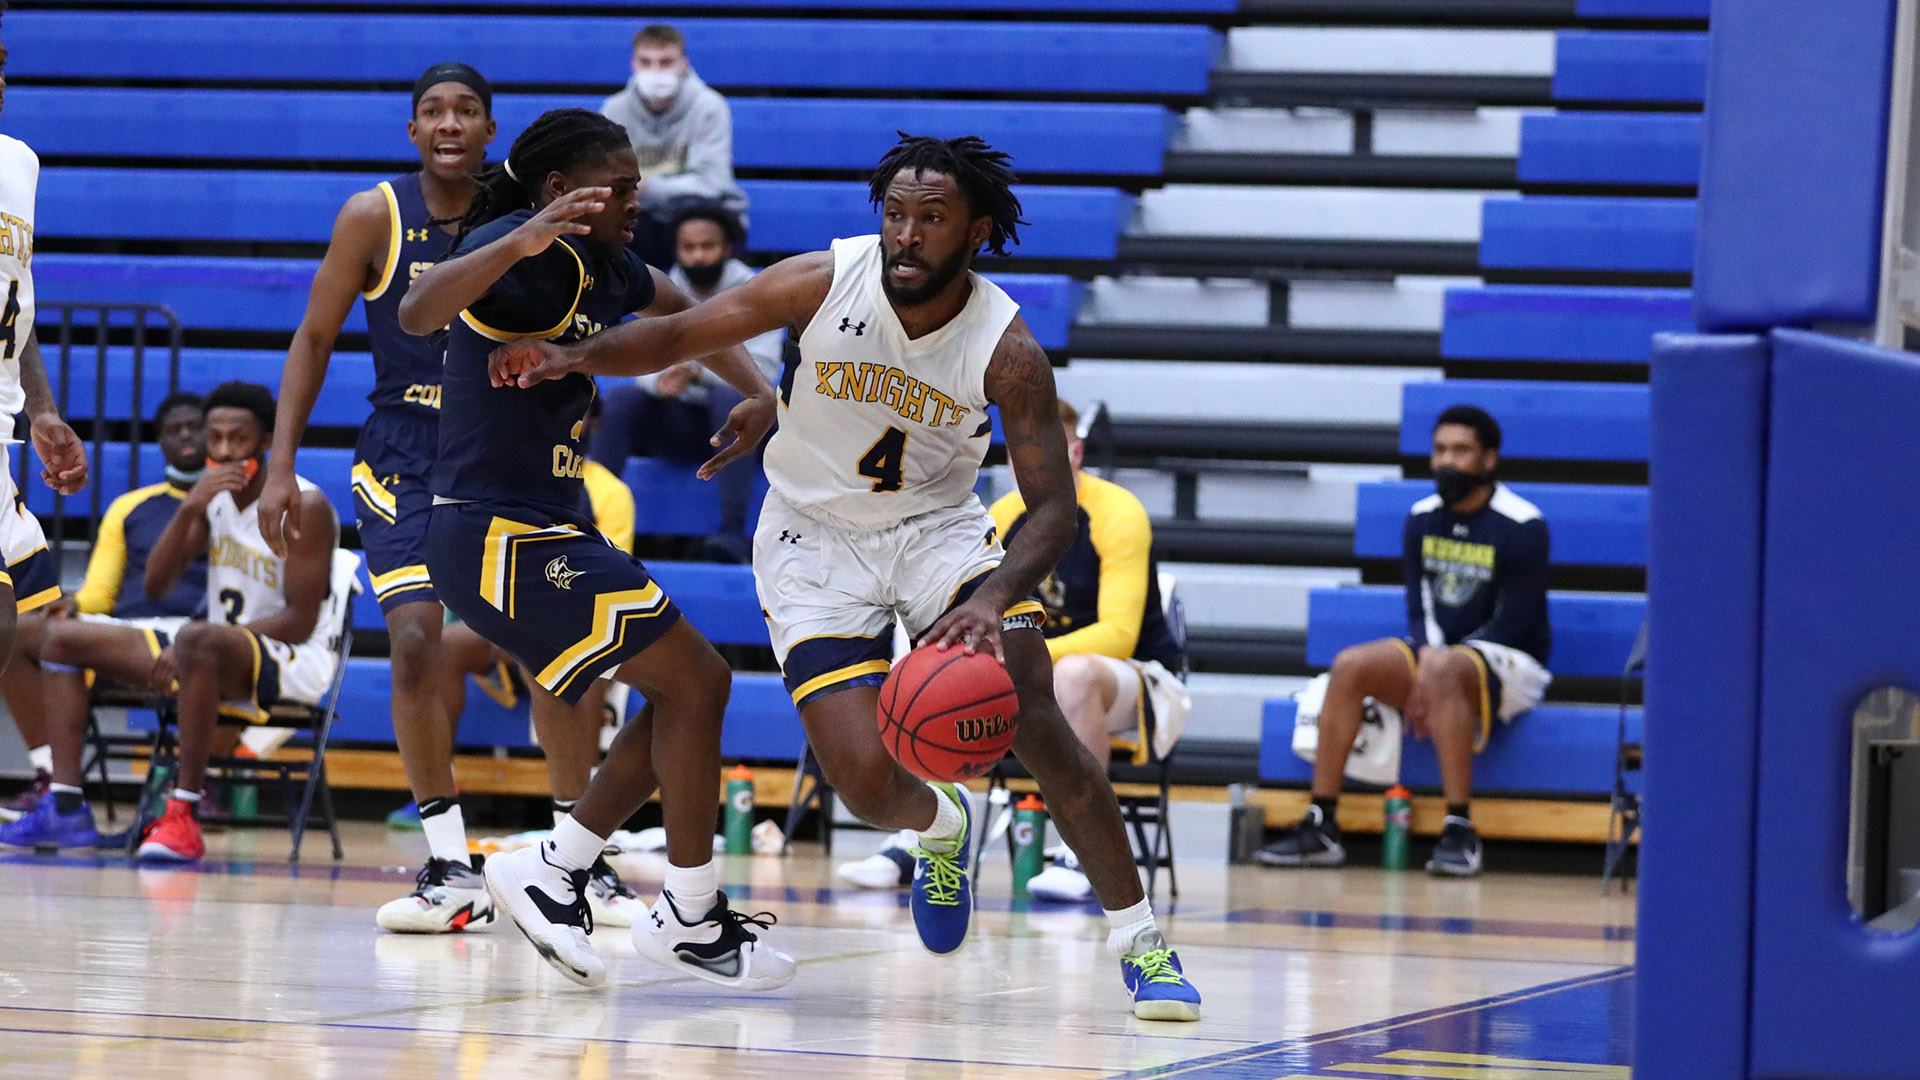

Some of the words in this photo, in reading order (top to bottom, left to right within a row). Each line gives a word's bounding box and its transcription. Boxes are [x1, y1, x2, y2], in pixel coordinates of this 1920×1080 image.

[0, 278, 21, 361] 4
[815, 361, 970, 428] KNIGHTS
[856, 424, 908, 492] 4
